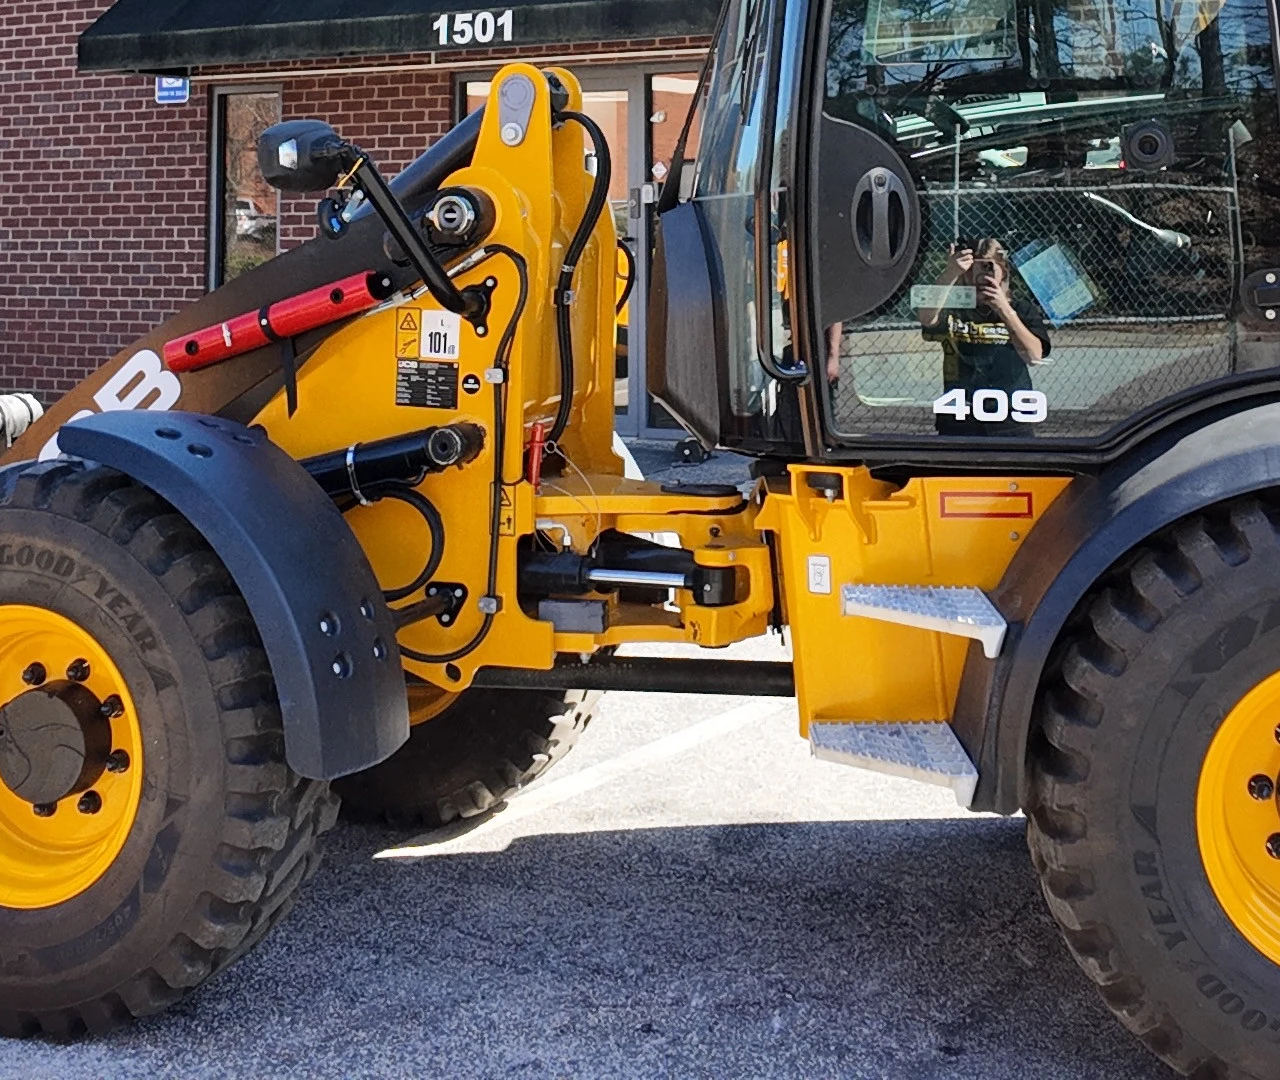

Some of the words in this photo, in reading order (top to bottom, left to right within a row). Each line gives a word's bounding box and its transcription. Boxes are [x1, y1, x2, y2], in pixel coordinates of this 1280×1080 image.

[432, 9, 514, 46] 1501
[428, 331, 448, 354] 101
[932, 388, 1048, 423] 409
